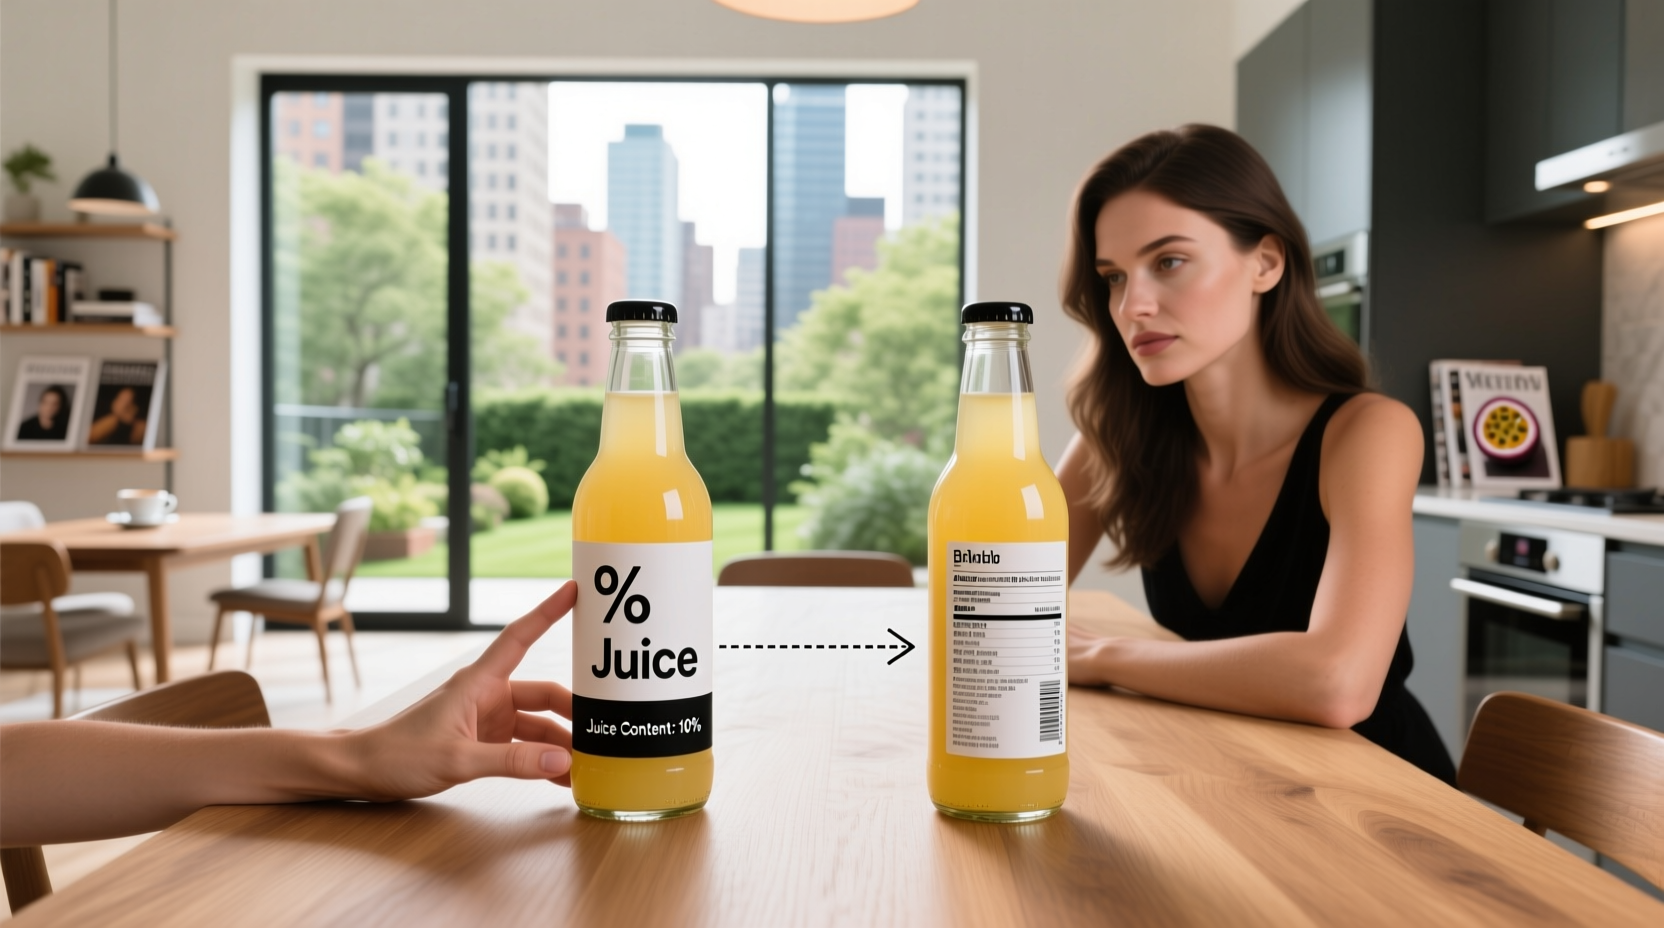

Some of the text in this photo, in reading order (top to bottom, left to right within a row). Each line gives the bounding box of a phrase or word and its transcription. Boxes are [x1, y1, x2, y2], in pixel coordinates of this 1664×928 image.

[594, 565, 651, 624] %
[591, 637, 698, 680] Juice
[586, 716, 702, 736] Juice Content: 10%
